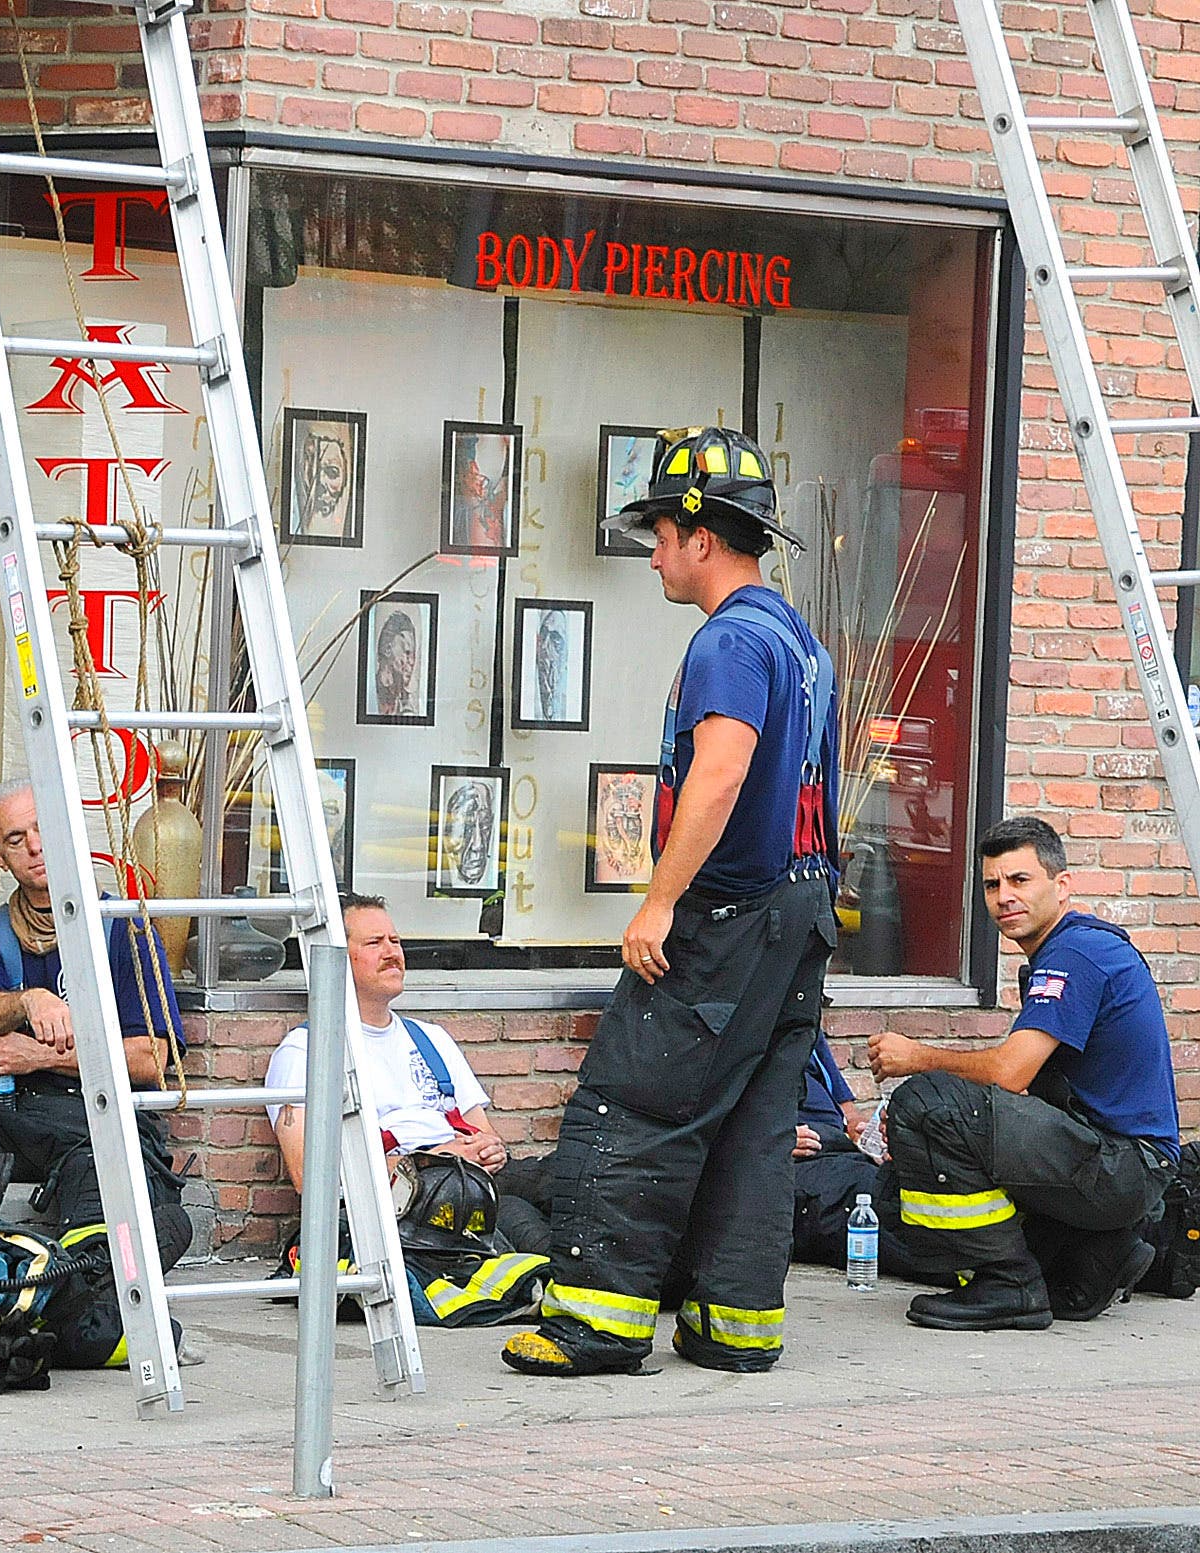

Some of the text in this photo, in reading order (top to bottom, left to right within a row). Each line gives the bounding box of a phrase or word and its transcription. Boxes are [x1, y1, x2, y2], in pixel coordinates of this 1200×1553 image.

[476, 229, 793, 309] BODY PIERCING
[23, 190, 190, 900] TATTO
